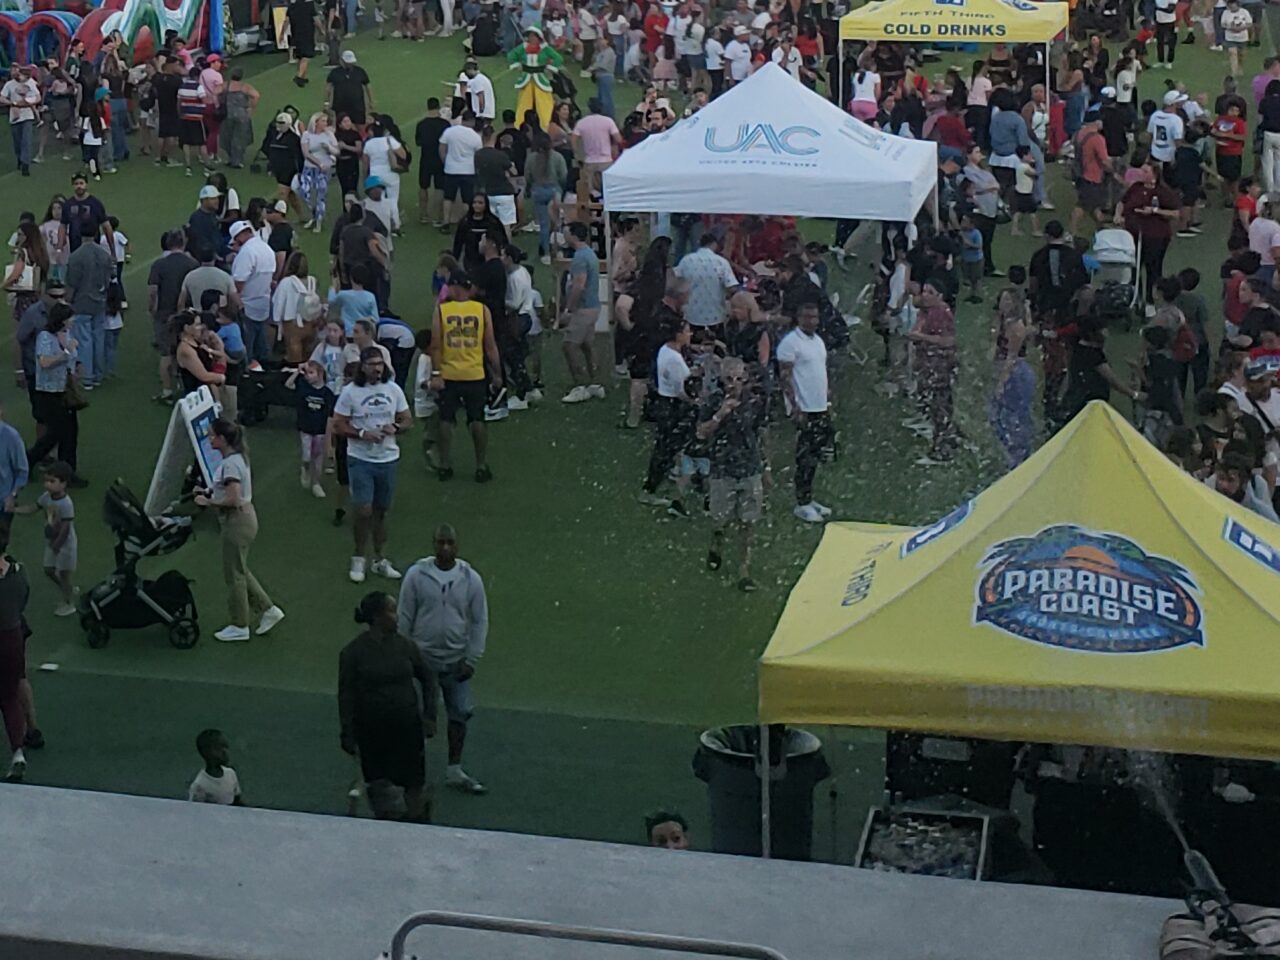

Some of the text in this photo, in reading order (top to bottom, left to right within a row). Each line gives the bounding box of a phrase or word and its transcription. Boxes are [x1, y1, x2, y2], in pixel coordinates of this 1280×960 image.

[883, 24, 1006, 36] COLD DRINKS
[704, 123, 821, 155] UAC
[1003, 568, 1179, 621] PARADISE
[1040, 592, 1139, 625] COAST
